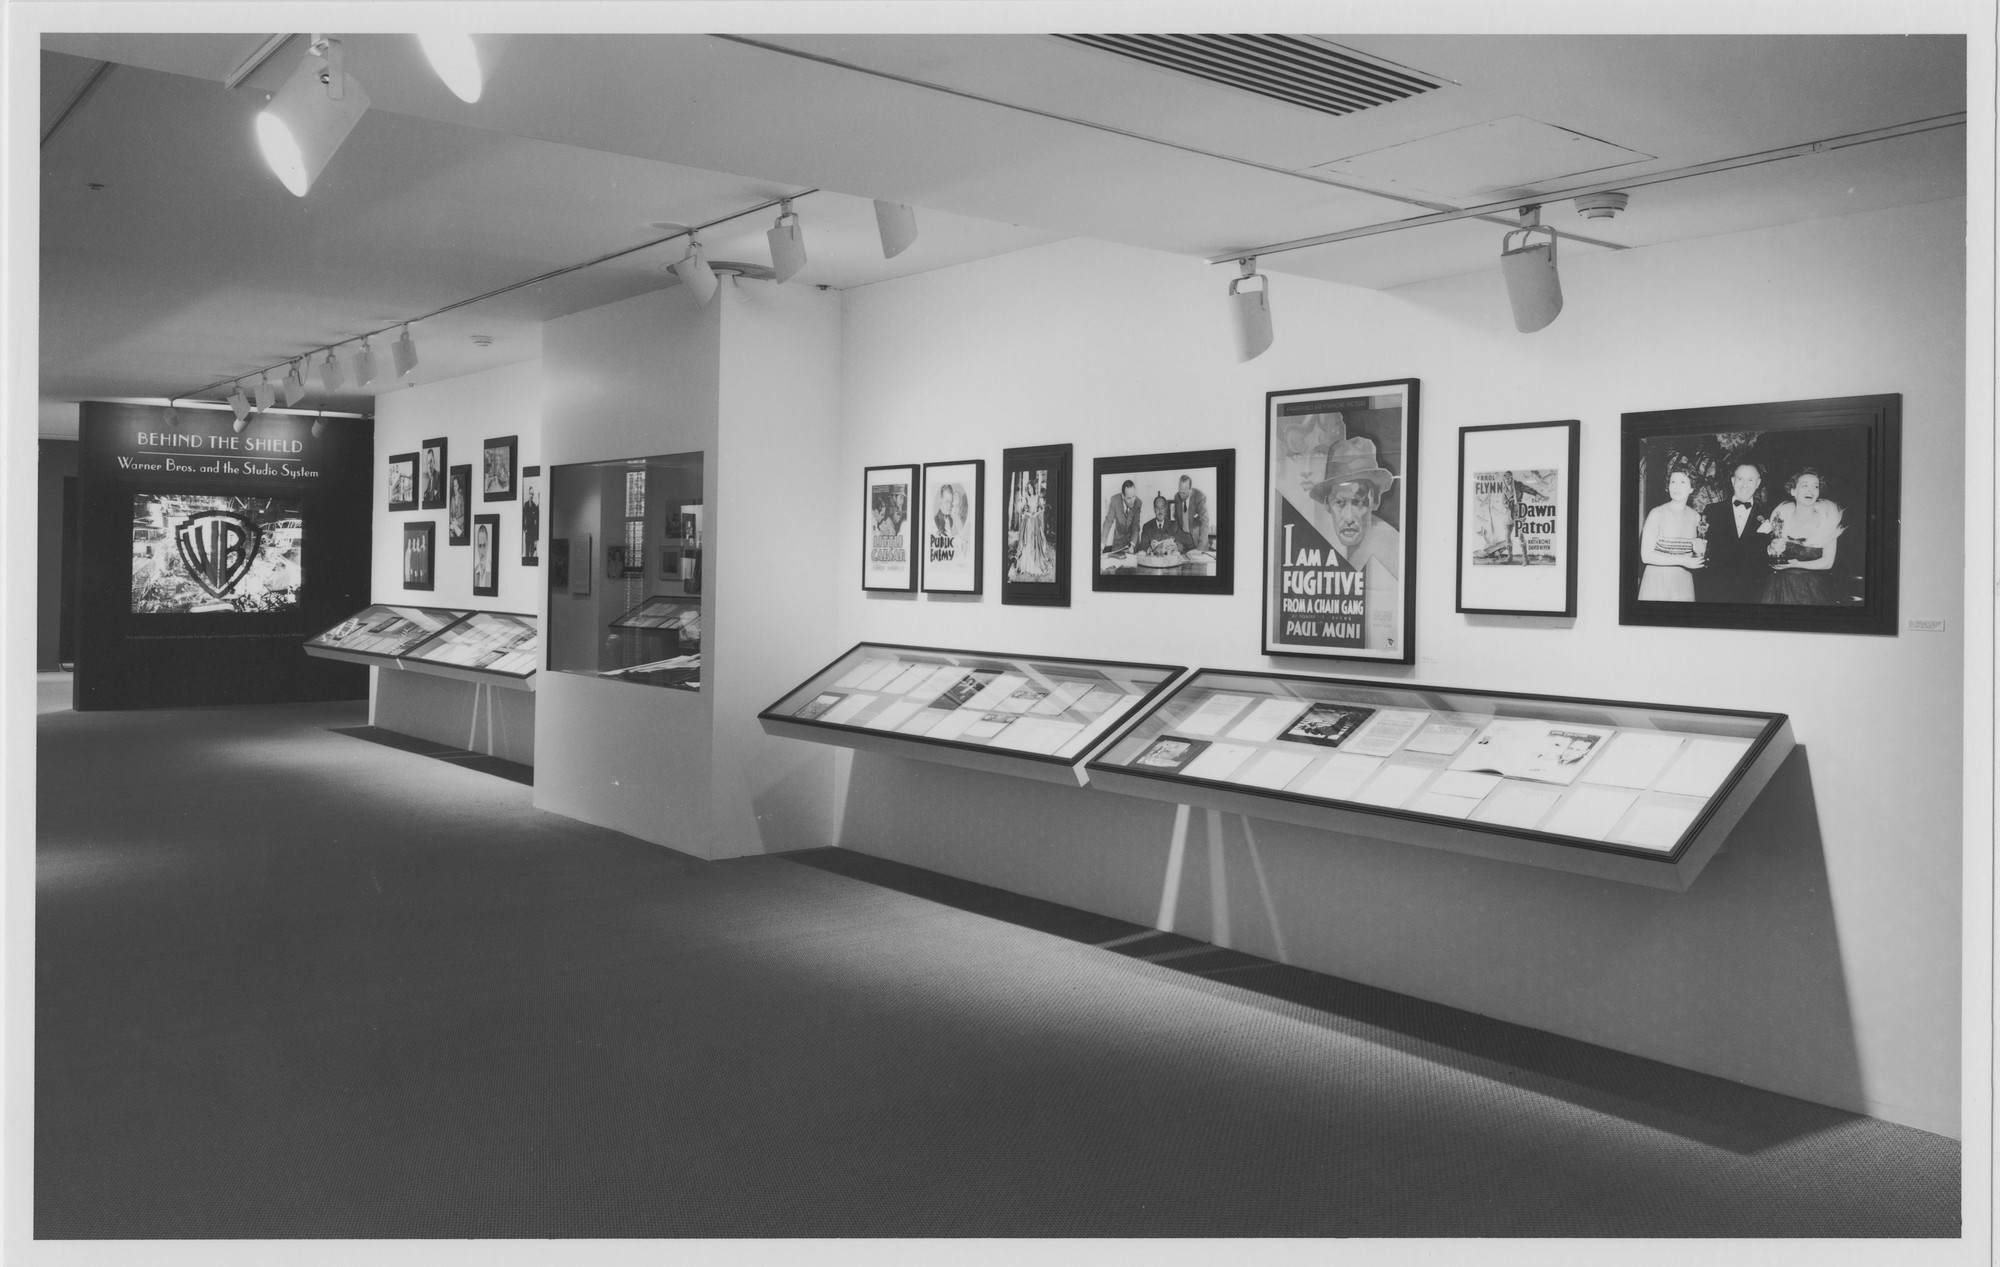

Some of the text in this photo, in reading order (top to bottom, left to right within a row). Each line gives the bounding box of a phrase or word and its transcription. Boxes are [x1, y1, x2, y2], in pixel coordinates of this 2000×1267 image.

[138, 432, 303, 453] BEHIND THE SHIELD
[117, 456, 319, 479] Warner Bros. and the Studio System
[1475, 481, 1503, 494] FLYNN
[1518, 502, 1556, 519] Dawn
[1514, 519, 1556, 537] Patrol
[930, 534, 955, 549] PUBLIC
[1282, 523, 1339, 567] I AM A
[930, 548, 955, 563] ENEMY
[1283, 570, 1364, 596] FUGITIVE
[1283, 598, 1364, 615] FROM A CHAIN GANG
[1286, 620, 1361, 639] PAUL MUNI
